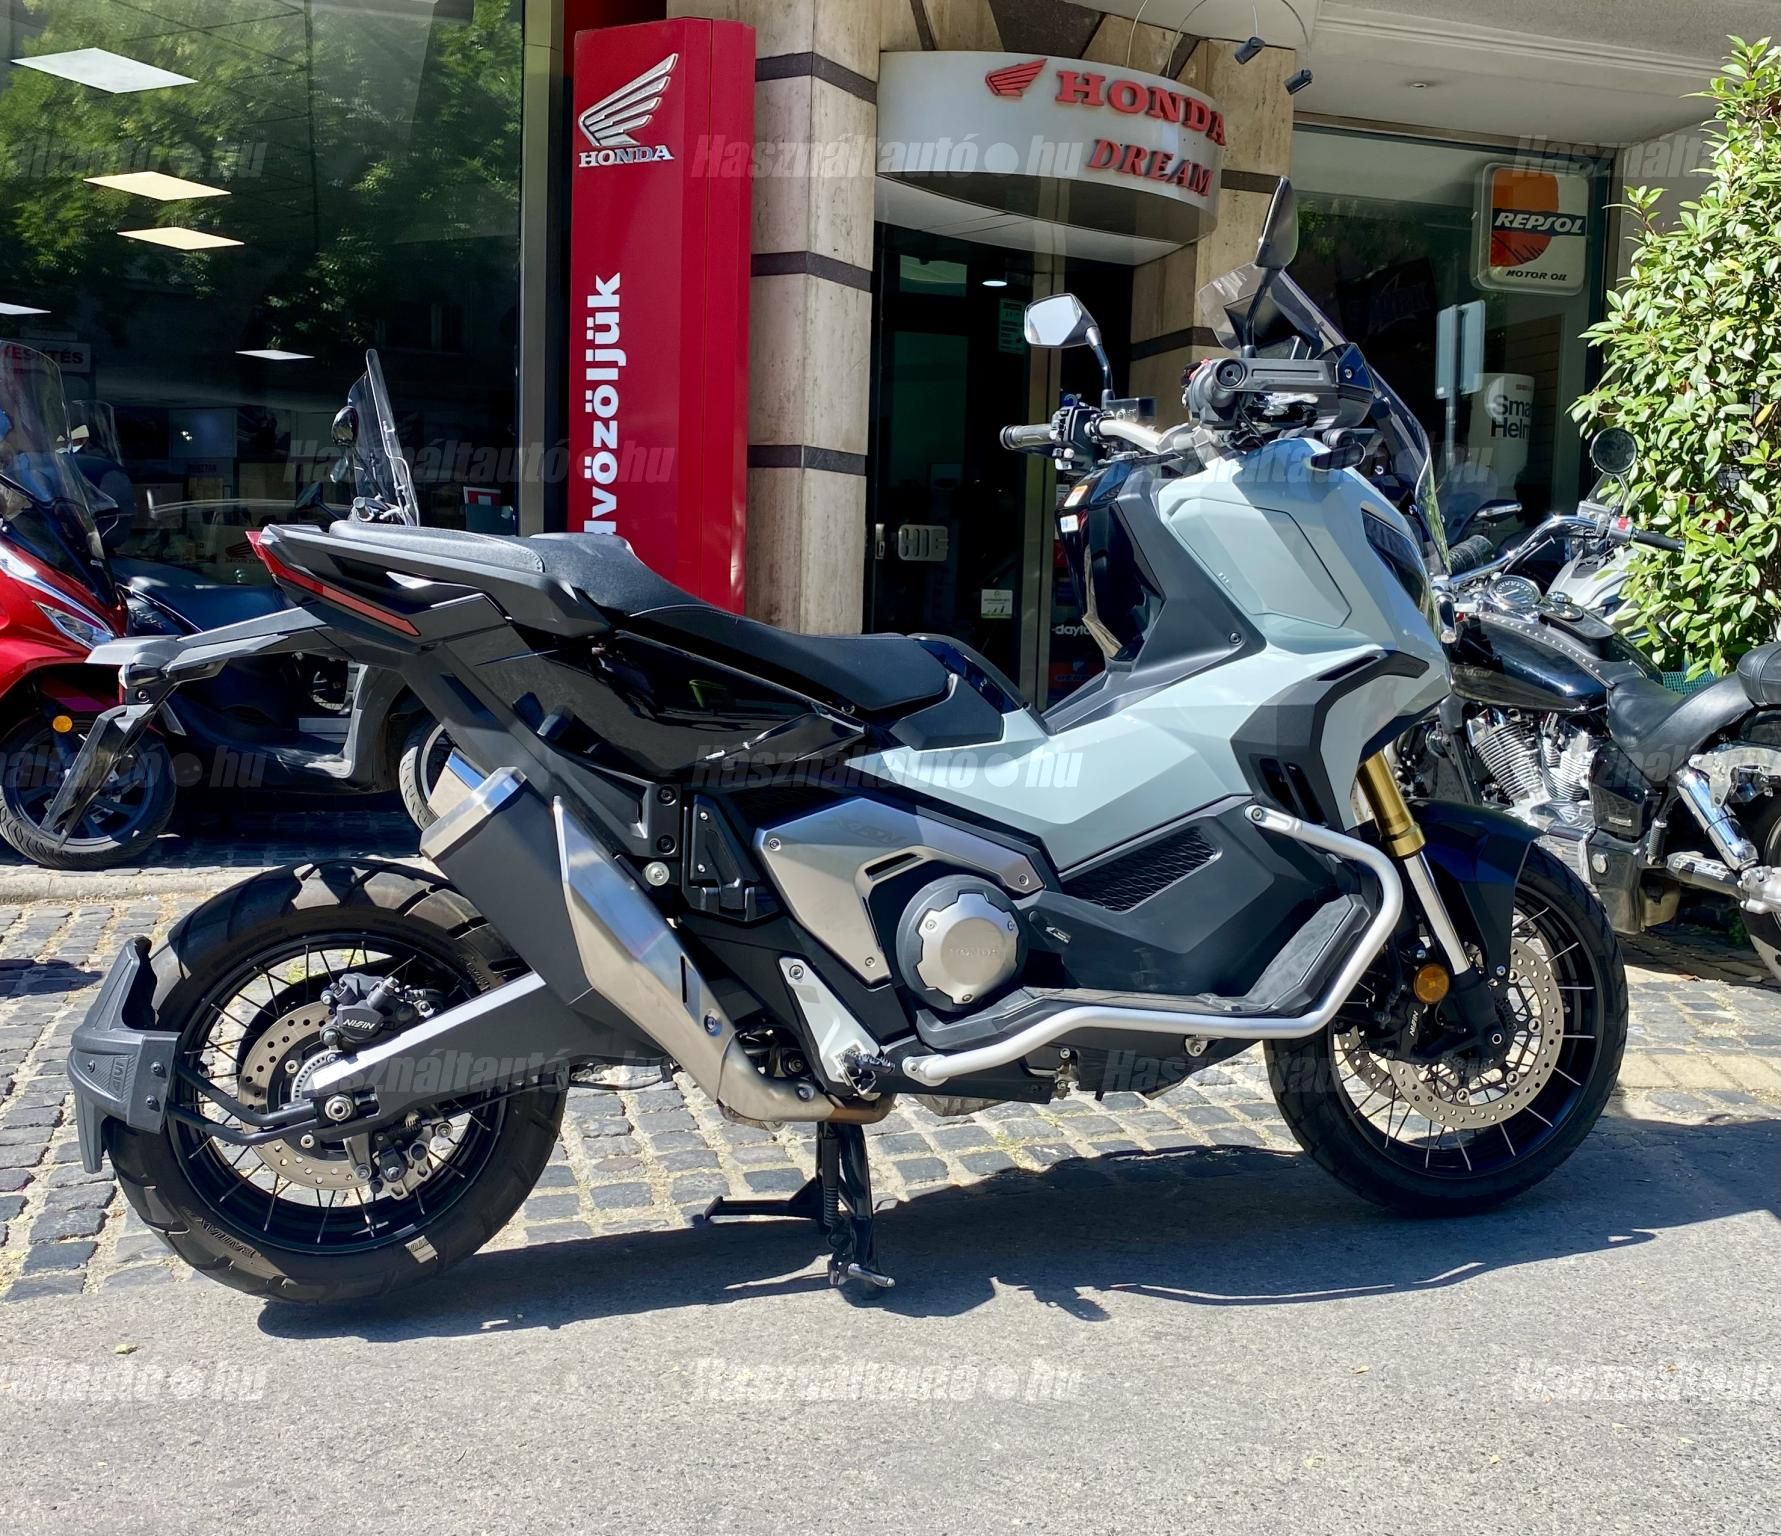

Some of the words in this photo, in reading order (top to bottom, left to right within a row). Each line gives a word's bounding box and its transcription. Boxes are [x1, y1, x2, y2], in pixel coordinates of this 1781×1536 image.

[1055, 71, 1226, 146] HONDA
[578, 145, 675, 168] HONDA
[1088, 139, 1214, 197] DREAM
[1494, 211, 1584, 233] REPSOL
[1506, 270, 1547, 280] MOTOR
[1551, 273, 1568, 281] OIL
